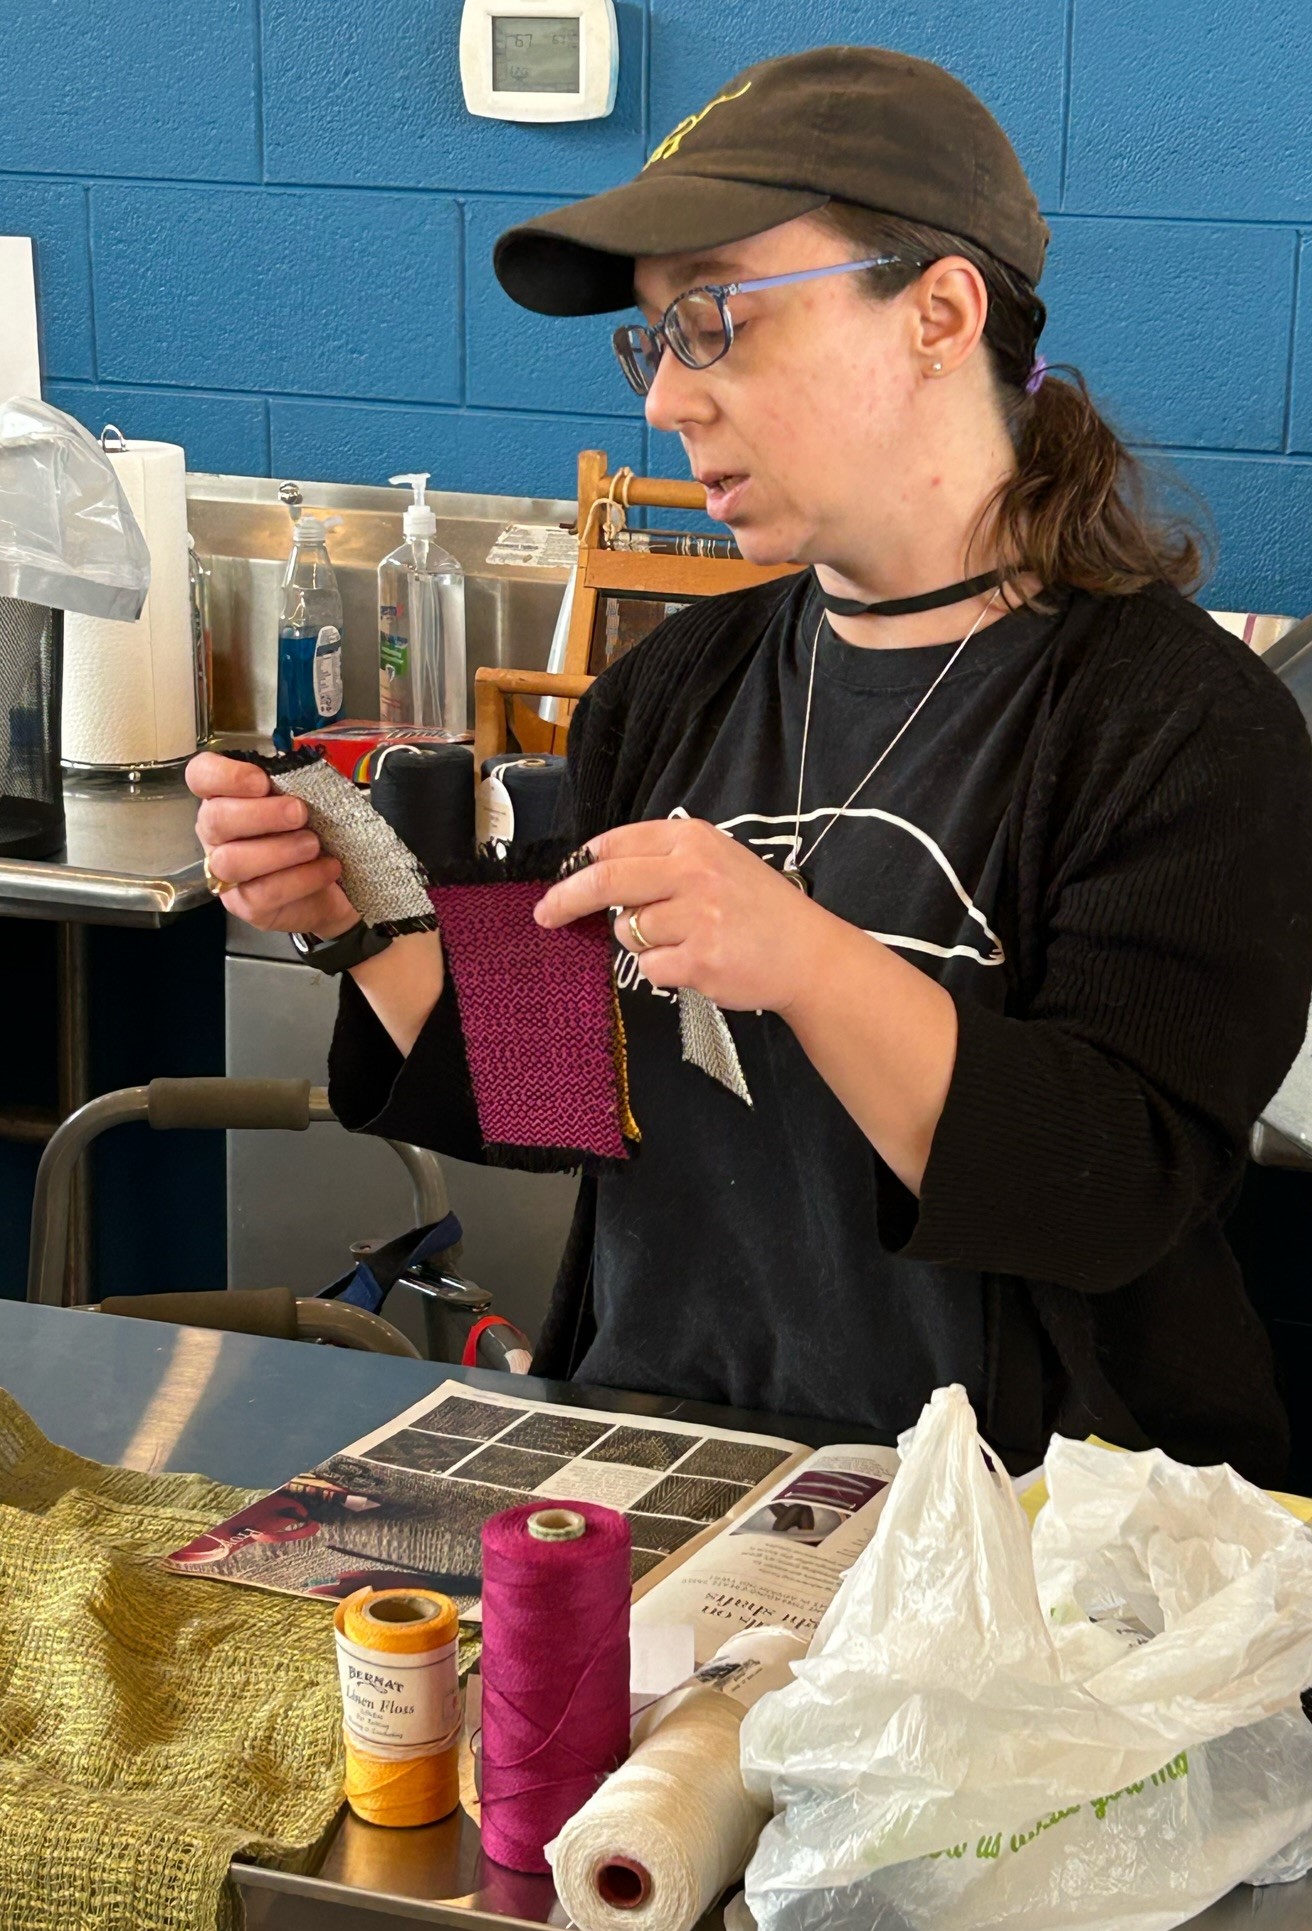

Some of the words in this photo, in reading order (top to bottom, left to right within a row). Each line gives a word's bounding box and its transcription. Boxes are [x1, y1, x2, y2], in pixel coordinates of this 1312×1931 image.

[701, 1605, 732, 1619] on
[347, 1665, 405, 1693] BERNAT
[379, 1698, 415, 1715] Floss
